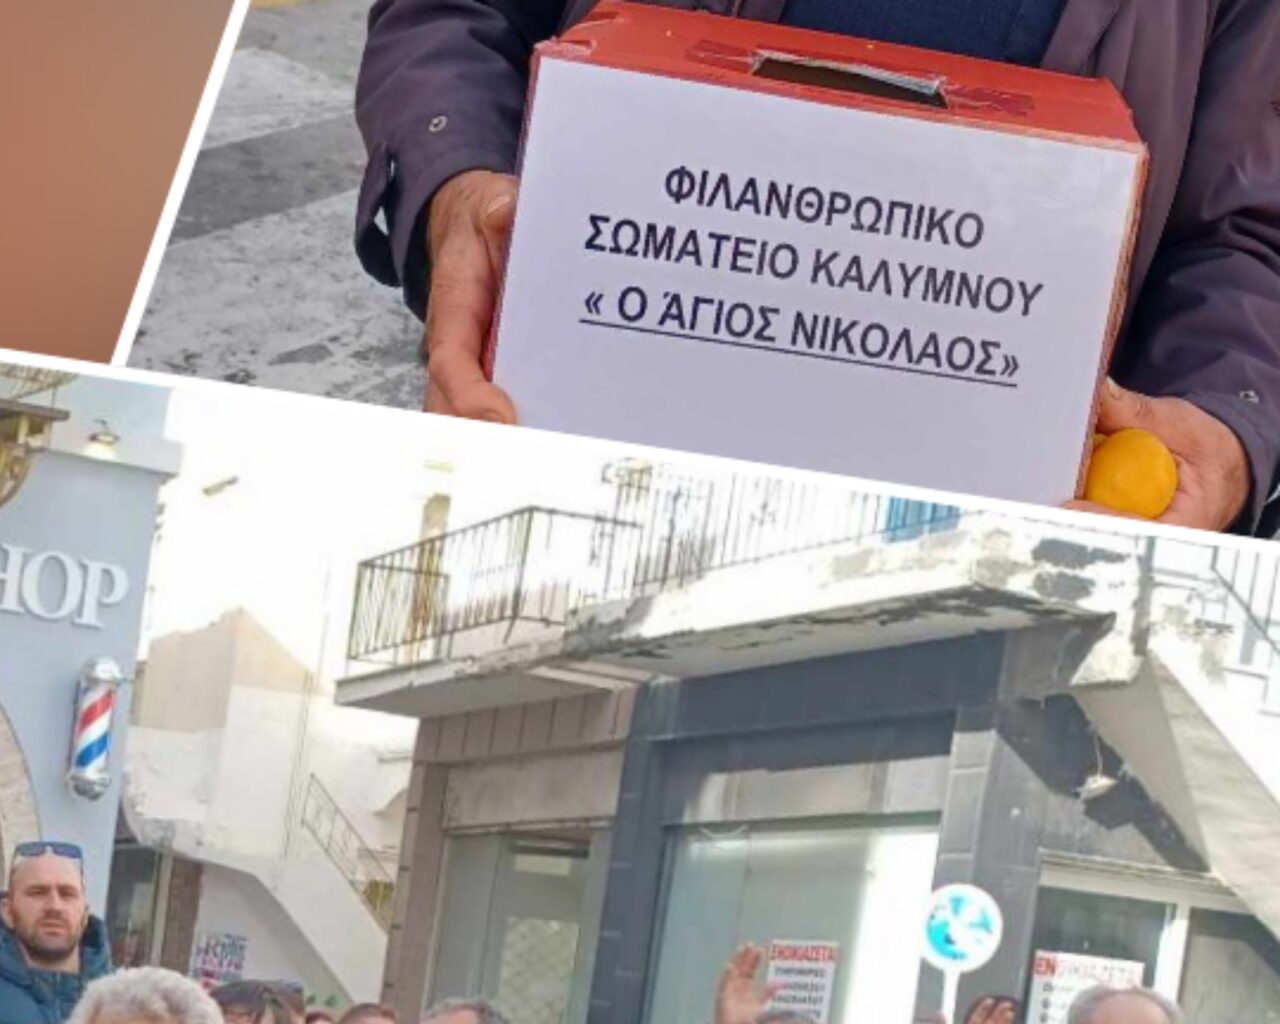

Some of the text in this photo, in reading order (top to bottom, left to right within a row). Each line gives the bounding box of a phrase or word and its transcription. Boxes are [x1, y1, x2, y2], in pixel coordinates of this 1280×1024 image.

[665, 165, 985, 250] ΦΙΛΑΝΘΡΩΠΙΚΟ
[584, 214, 1045, 318] ΣΩΜΑΤΕΙΟ ΚΑΛΥΜΝΟΥ
[617, 286, 648, 323] Ο
[790, 310, 1020, 378] ΝΙΚΟΛΑΟΣ»
